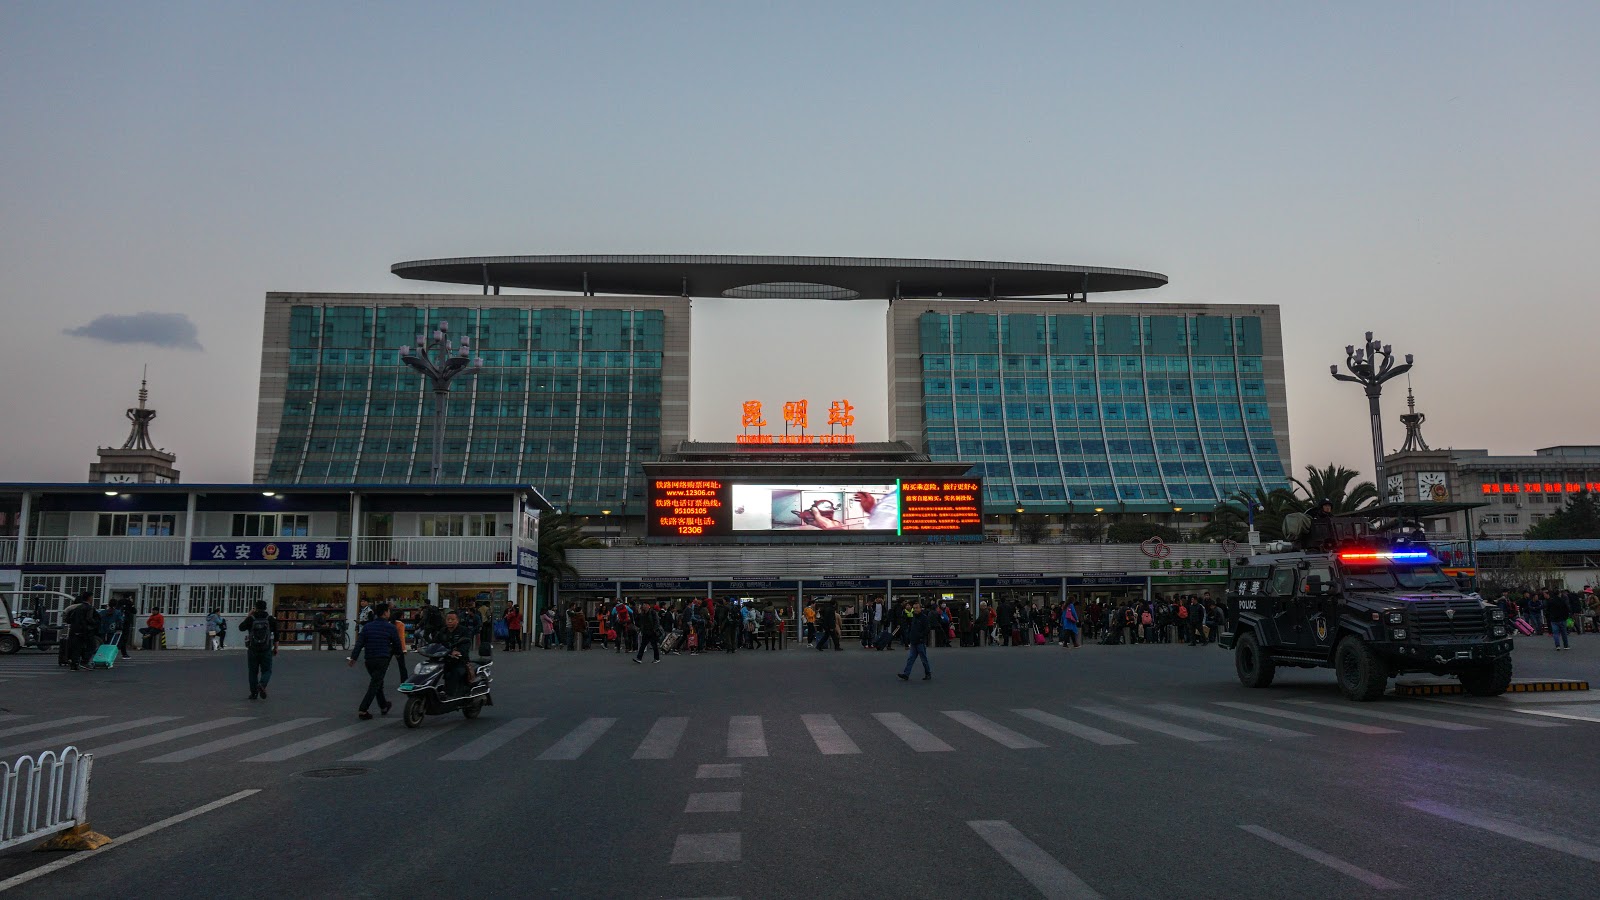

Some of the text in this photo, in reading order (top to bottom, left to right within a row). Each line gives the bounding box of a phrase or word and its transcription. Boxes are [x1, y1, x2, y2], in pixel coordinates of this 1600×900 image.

[742, 399, 854, 428] 昆明站
[737, 435, 855, 444] KUNMING RAILWAY STATION
[1482, 483, 1500, 493] 富强
[1503, 483, 1520, 493] 民主
[1524, 483, 1541, 493] 文明
[1544, 483, 1562, 493] 和谐
[1565, 483, 1581, 493] 自由
[211, 544, 331, 559] 公安 联勤
[1238, 581, 1260, 595] 特警
[1238, 600, 1257, 609] POLICE
